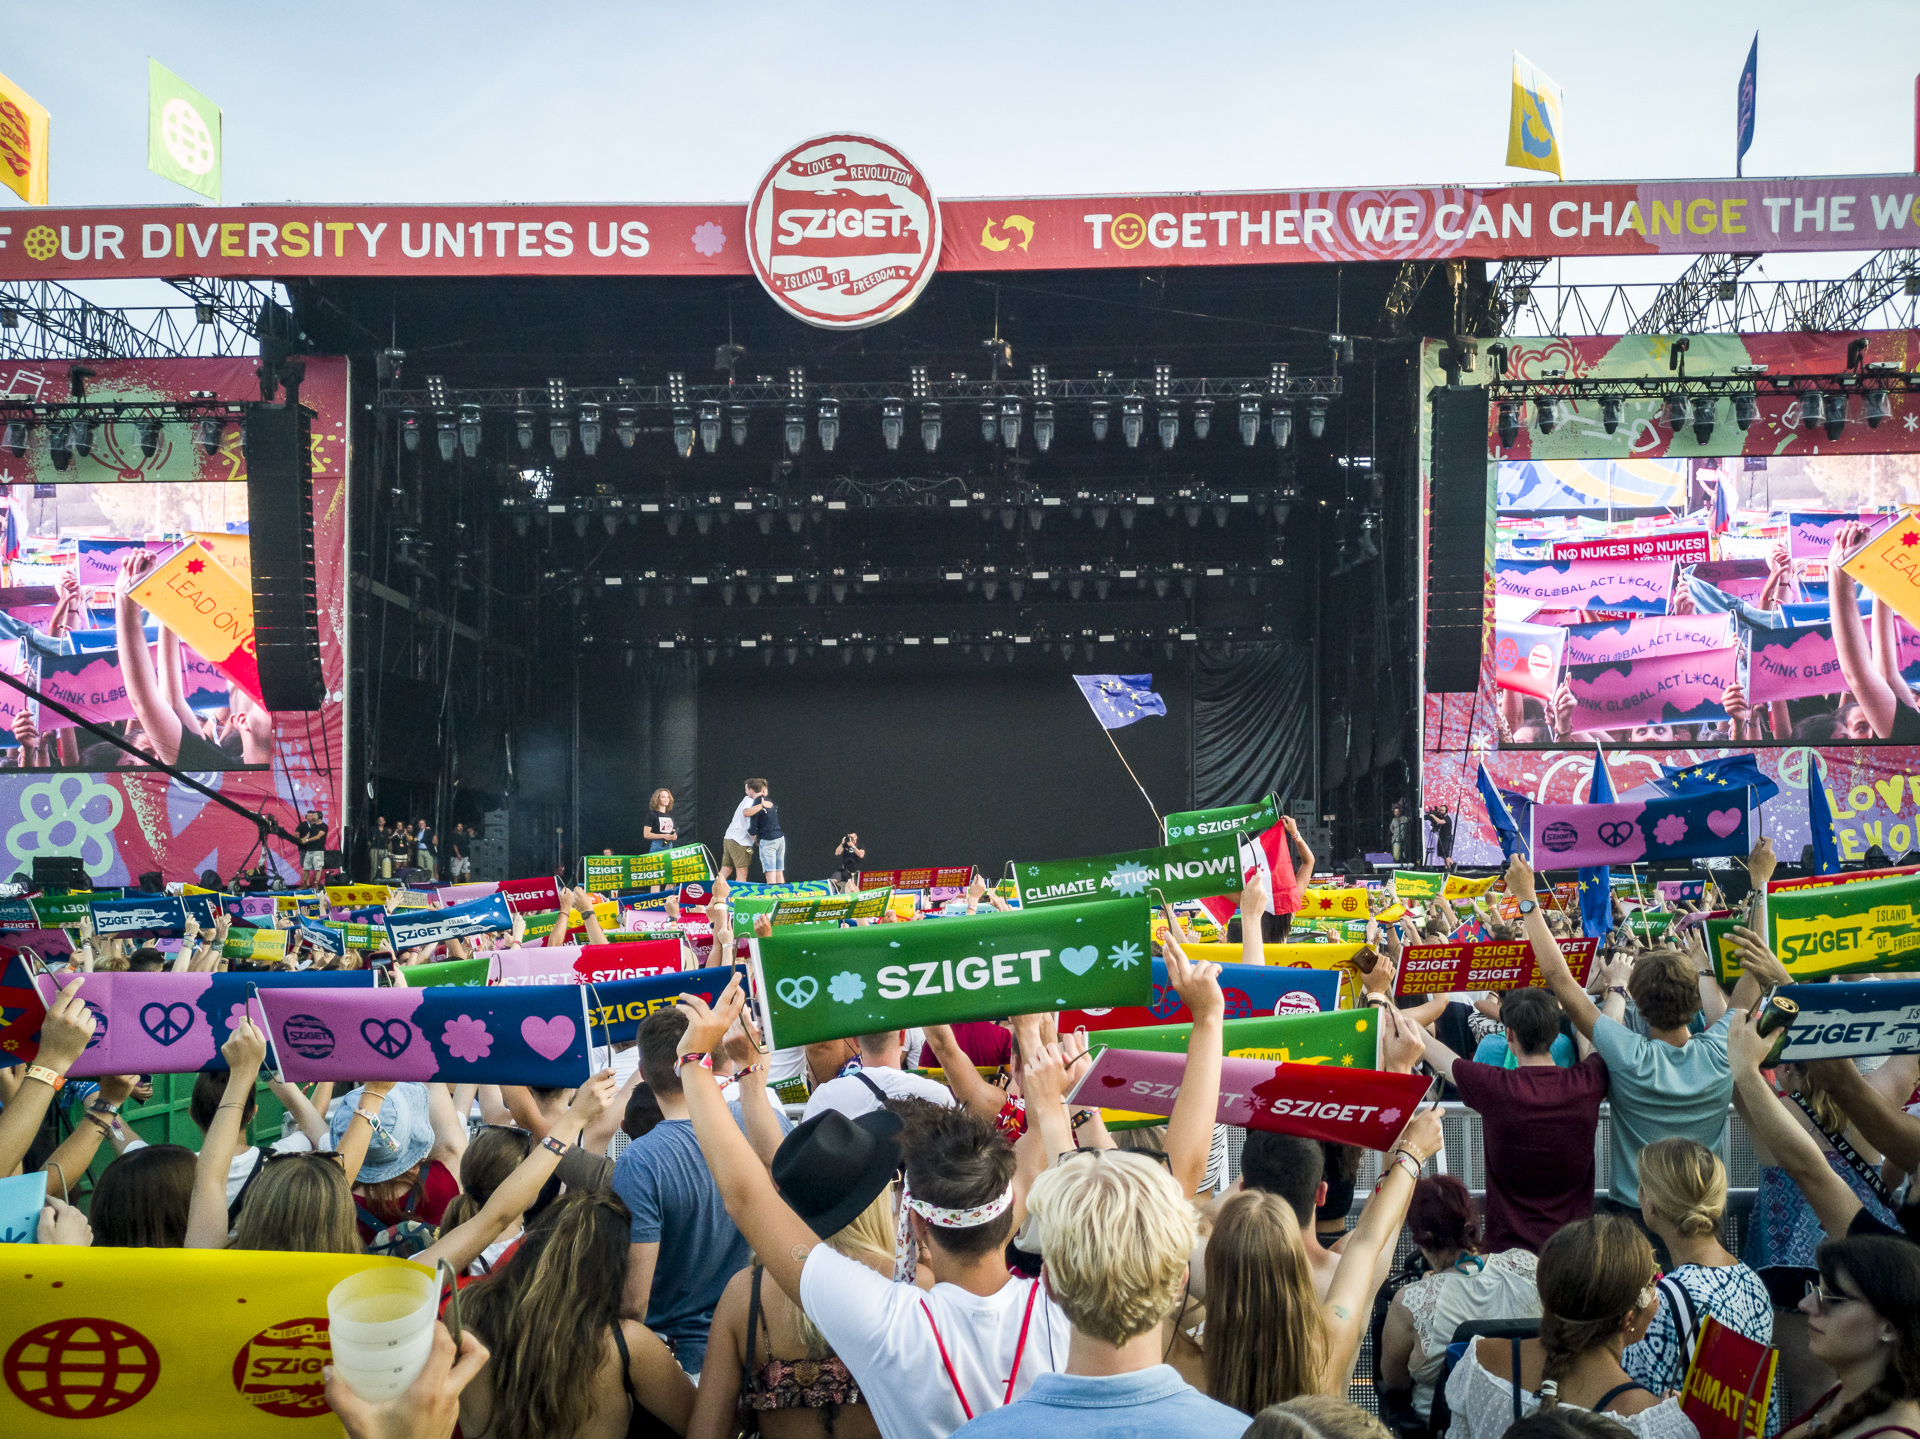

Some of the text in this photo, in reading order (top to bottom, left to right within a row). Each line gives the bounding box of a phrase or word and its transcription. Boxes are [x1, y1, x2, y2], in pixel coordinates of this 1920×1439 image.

[807, 157, 913, 187] LOVE REVOLUTION
[1349, 205, 1420, 243] WE
[1434, 202, 1532, 242] CAN
[1548, 198, 1747, 237] CHANGE
[1762, 195, 1856, 233] THE
[142, 221, 388, 259] DIVERSITY
[588, 220, 650, 258] US
[784, 267, 896, 294] ISLAND OF FREEDOM
[1798, 530, 1831, 547] THINK
[1581, 543, 1630, 559] NUKES!
[1656, 537, 1706, 553] NUKES!
[86, 556, 118, 574] THINK
[1496, 576, 1532, 597] THINK
[1590, 576, 1615, 589] ACT
[166, 573, 247, 640] LEAD ON
[1649, 632, 1671, 649] ACT
[1758, 655, 1841, 679] THINK GLOB
[1657, 674, 1681, 693] ACT
[49, 682, 128, 705] THINK GLOB
[1197, 815, 1249, 834] SZIGET
[587, 845, 702, 866] SZIGET SZIGET SZIGET
[588, 855, 703, 875] SZIGET SZIGET SZIGET
[589, 863, 705, 883] SZIGET SZIGET SZIGET
[589, 872, 706, 891] SZIGET SZIGET SZIGET
[1025, 856, 1236, 901] CLIMATE ACTION NOW!
[507, 890, 545, 901] SZIGET
[857, 890, 889, 902] SZIGET
[777, 906, 812, 914] SZIGET
[855, 897, 887, 908] SZIGET
[814, 909, 848, 918] SZIGET
[1876, 908, 1907, 923] ISLAND
[531, 923, 556, 935] SZIG
[650, 932, 681, 940] SZIGET
[1201, 928, 1219, 938] ZiGE
[1347, 924, 1366, 932] SZIG
[1877, 933, 1920, 951] OF FREED
[1408, 947, 1463, 960] SZIGET
[1472, 944, 1527, 957] SZIGET
[1406, 956, 1525, 971] SZIGET SZIGET
[592, 966, 659, 983] SZIGET
[877, 949, 1051, 999] SZIGET
[1403, 971, 1458, 983] SZIGET
[1467, 968, 1522, 981] SZIGET
[1401, 982, 1456, 994] SZIGET
[1465, 979, 1519, 991] SZIGET
[1897, 1031, 1912, 1044] OF
[1239, 1052, 1281, 1062] ISLAND
[775, 1077, 803, 1090] SZIG
[1270, 1098, 1379, 1124] SZIGET
[1829, 1133, 1856, 1161] LUB
[281, 1327, 302, 1337] LOVE
